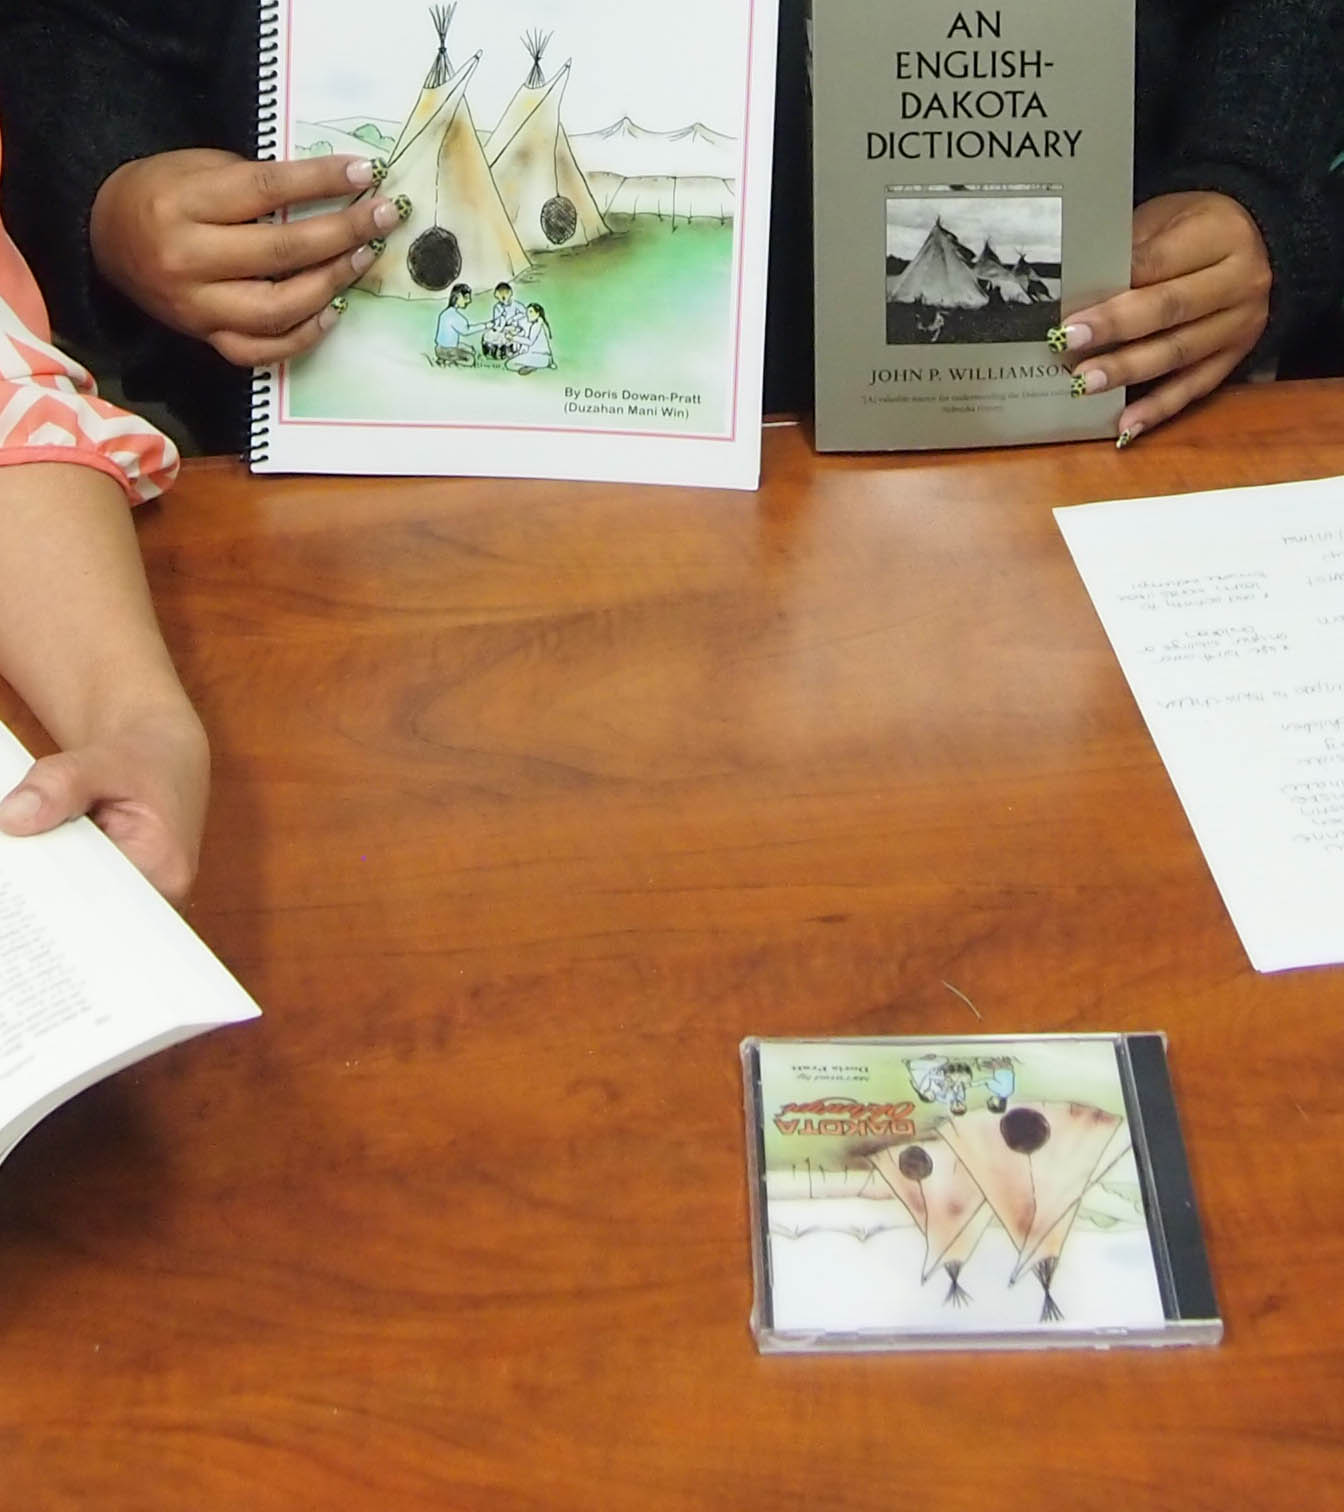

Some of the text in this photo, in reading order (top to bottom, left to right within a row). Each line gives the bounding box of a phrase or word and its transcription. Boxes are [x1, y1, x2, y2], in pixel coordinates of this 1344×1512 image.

[947, 11, 1001, 38] AN
[896, 50, 1054, 79] ENGLISH-
[901, 91, 1047, 119] DAKOTA
[867, 130, 1082, 160] DICTIONARY
[869, 364, 1074, 385] JOHN P. WILLIAMSON
[565, 387, 701, 404] By Doris Dowan-Pratt
[564, 403, 689, 419] (Duzahan Mani Win)
[774, 1118, 916, 1136] DAKOTA
